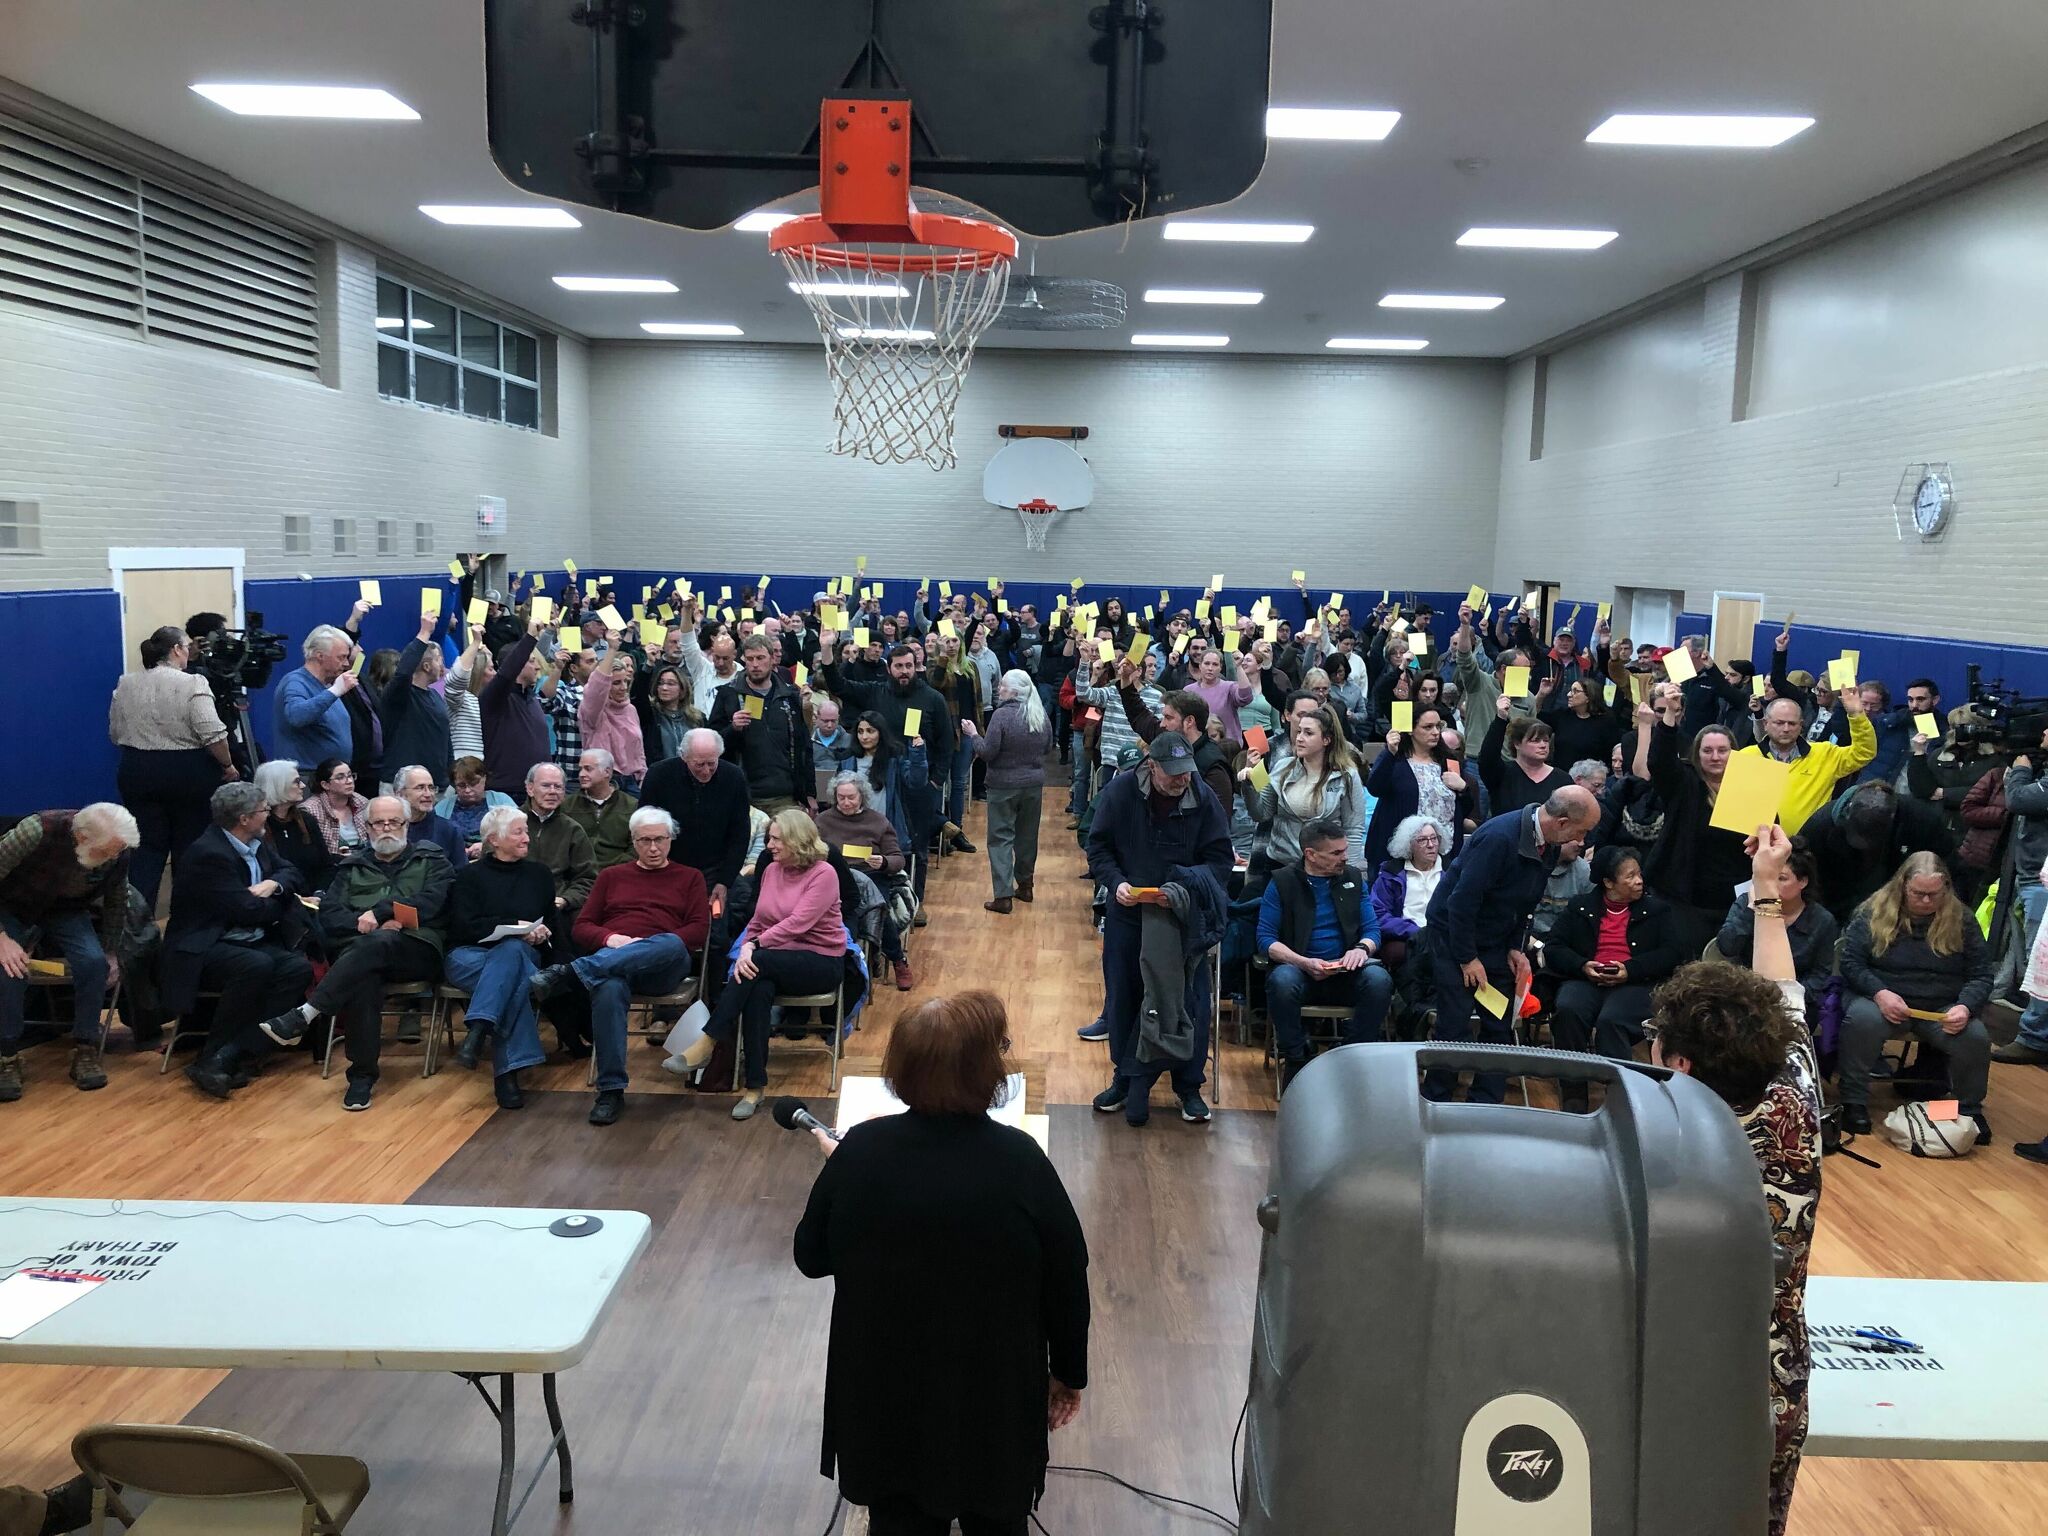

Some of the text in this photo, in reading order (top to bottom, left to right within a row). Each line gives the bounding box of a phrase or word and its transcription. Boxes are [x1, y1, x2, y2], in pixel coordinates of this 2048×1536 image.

[59, 1241, 178, 1252] BETHANY
[39, 1254, 162, 1266] TOWN OF
